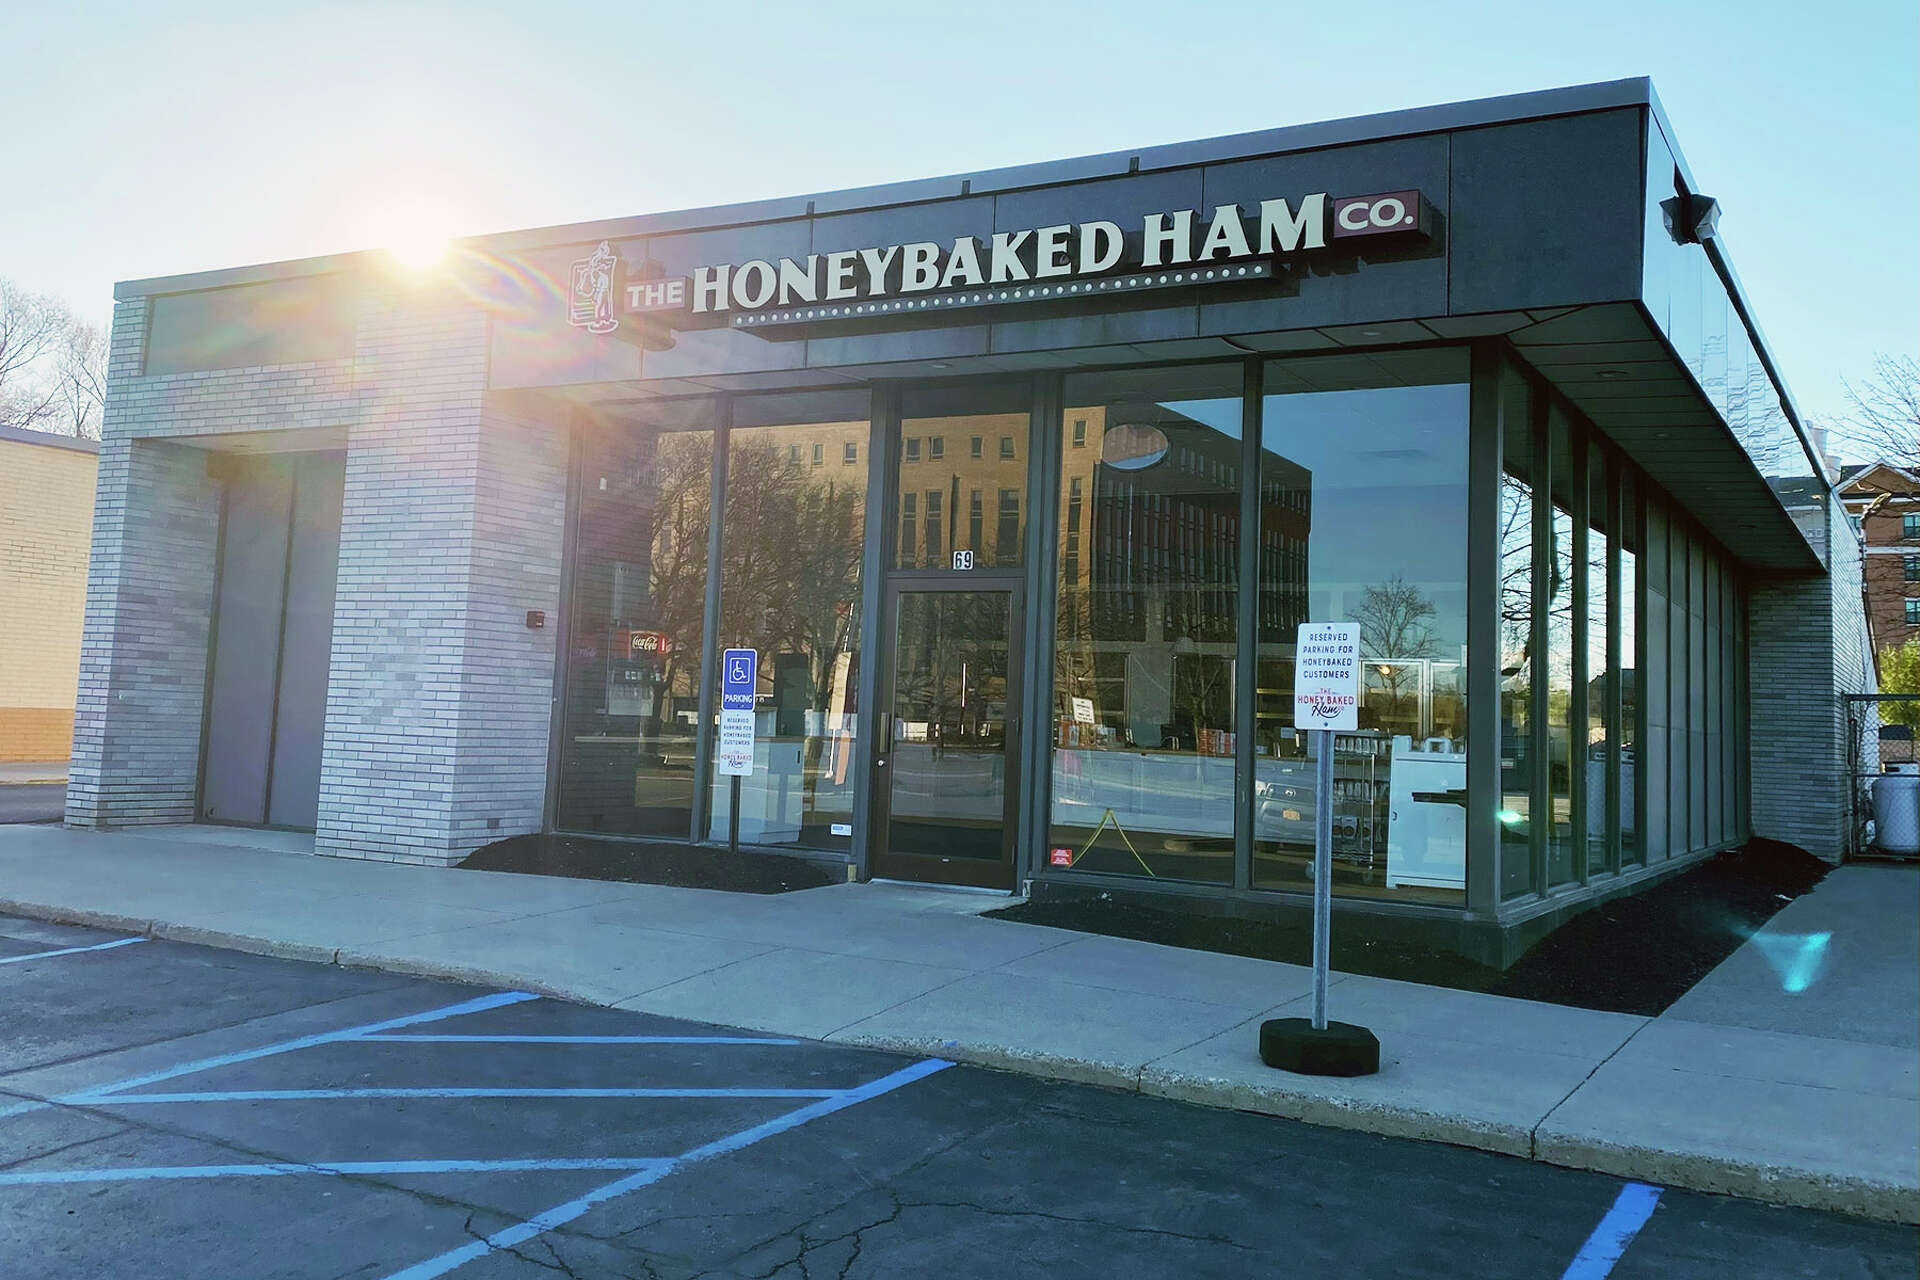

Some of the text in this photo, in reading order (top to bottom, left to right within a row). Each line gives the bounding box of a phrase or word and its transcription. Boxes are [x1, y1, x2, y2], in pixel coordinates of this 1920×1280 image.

[627, 192, 1415, 313] THE HONEYBAKED HAM CO.
[955, 551, 972, 569] 69
[1309, 633, 1348, 641] RESERVED
[1303, 645, 1353, 654] PARKING FOR
[1303, 658, 1352, 667] HONEYBAKED
[1303, 670, 1349, 679] CUSTOMERS
[725, 694, 753, 703] PARKING
